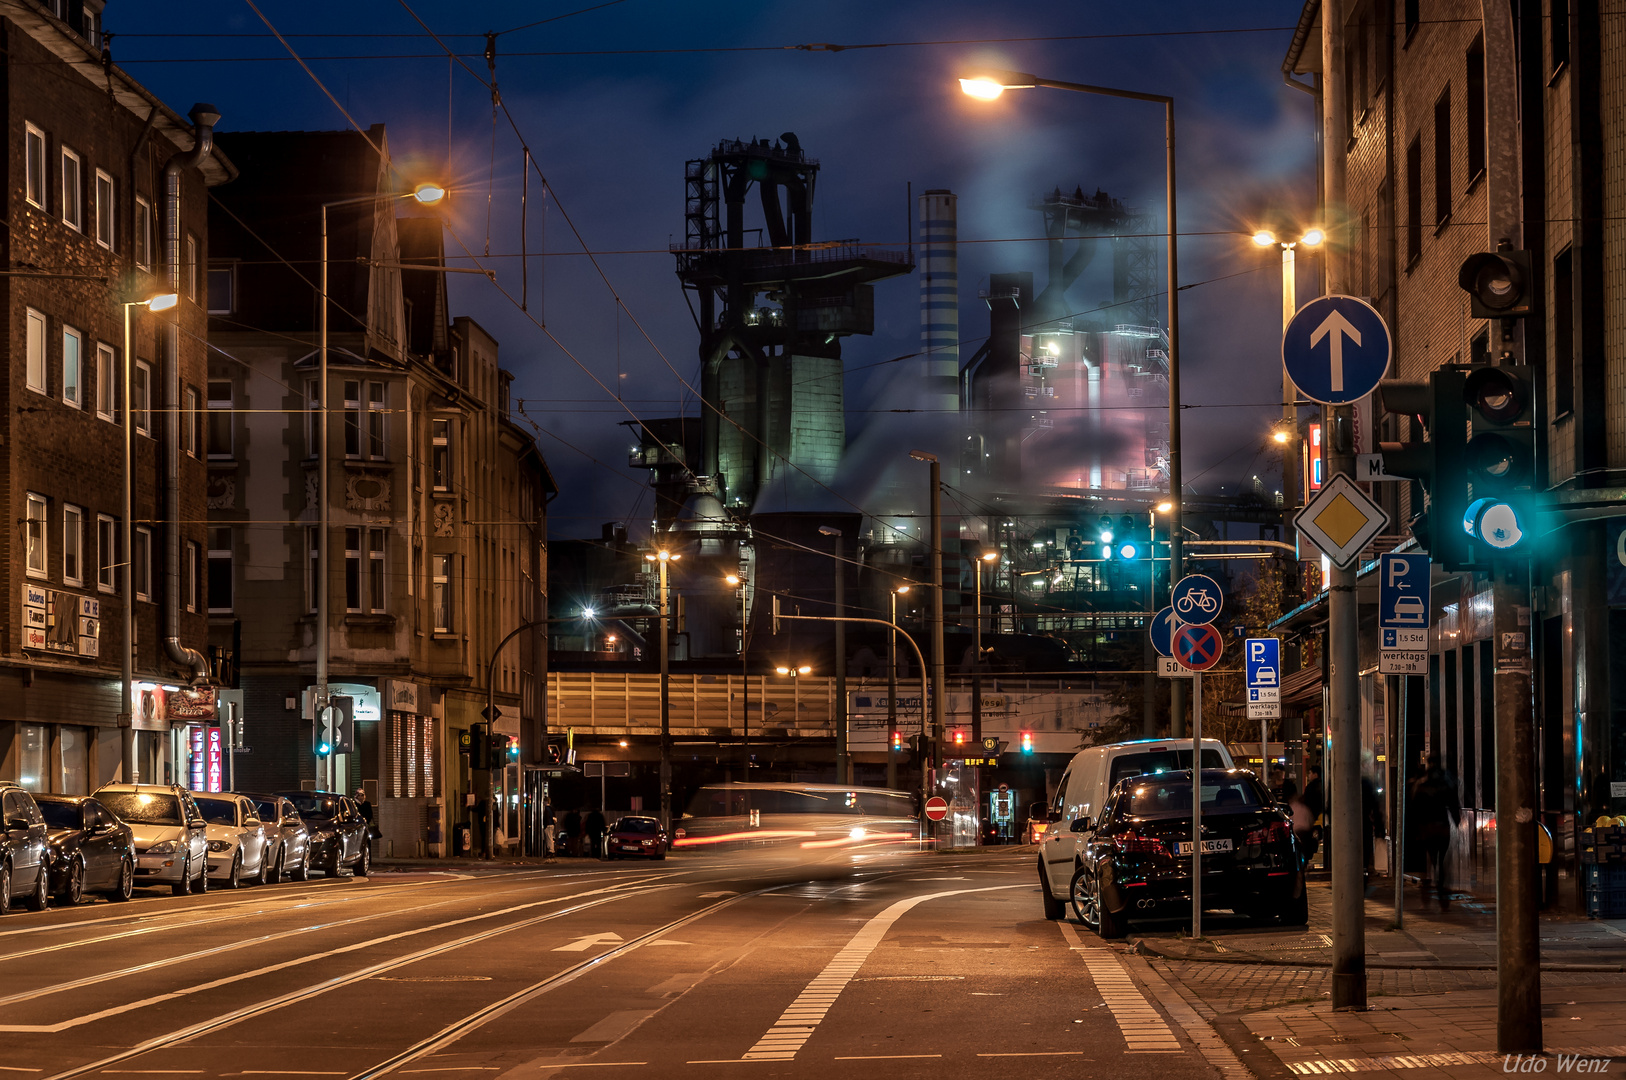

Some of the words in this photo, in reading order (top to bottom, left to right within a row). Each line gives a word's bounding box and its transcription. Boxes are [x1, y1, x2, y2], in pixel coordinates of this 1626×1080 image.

[1389, 558, 1410, 588] P
[1410, 634, 1426, 642] Std.
[1251, 642, 1266, 662] P
[1383, 651, 1426, 663] werktags
[1166, 661, 1178, 673] 50
[210, 731, 221, 793] SALATE
[1216, 840, 1228, 850] 64
